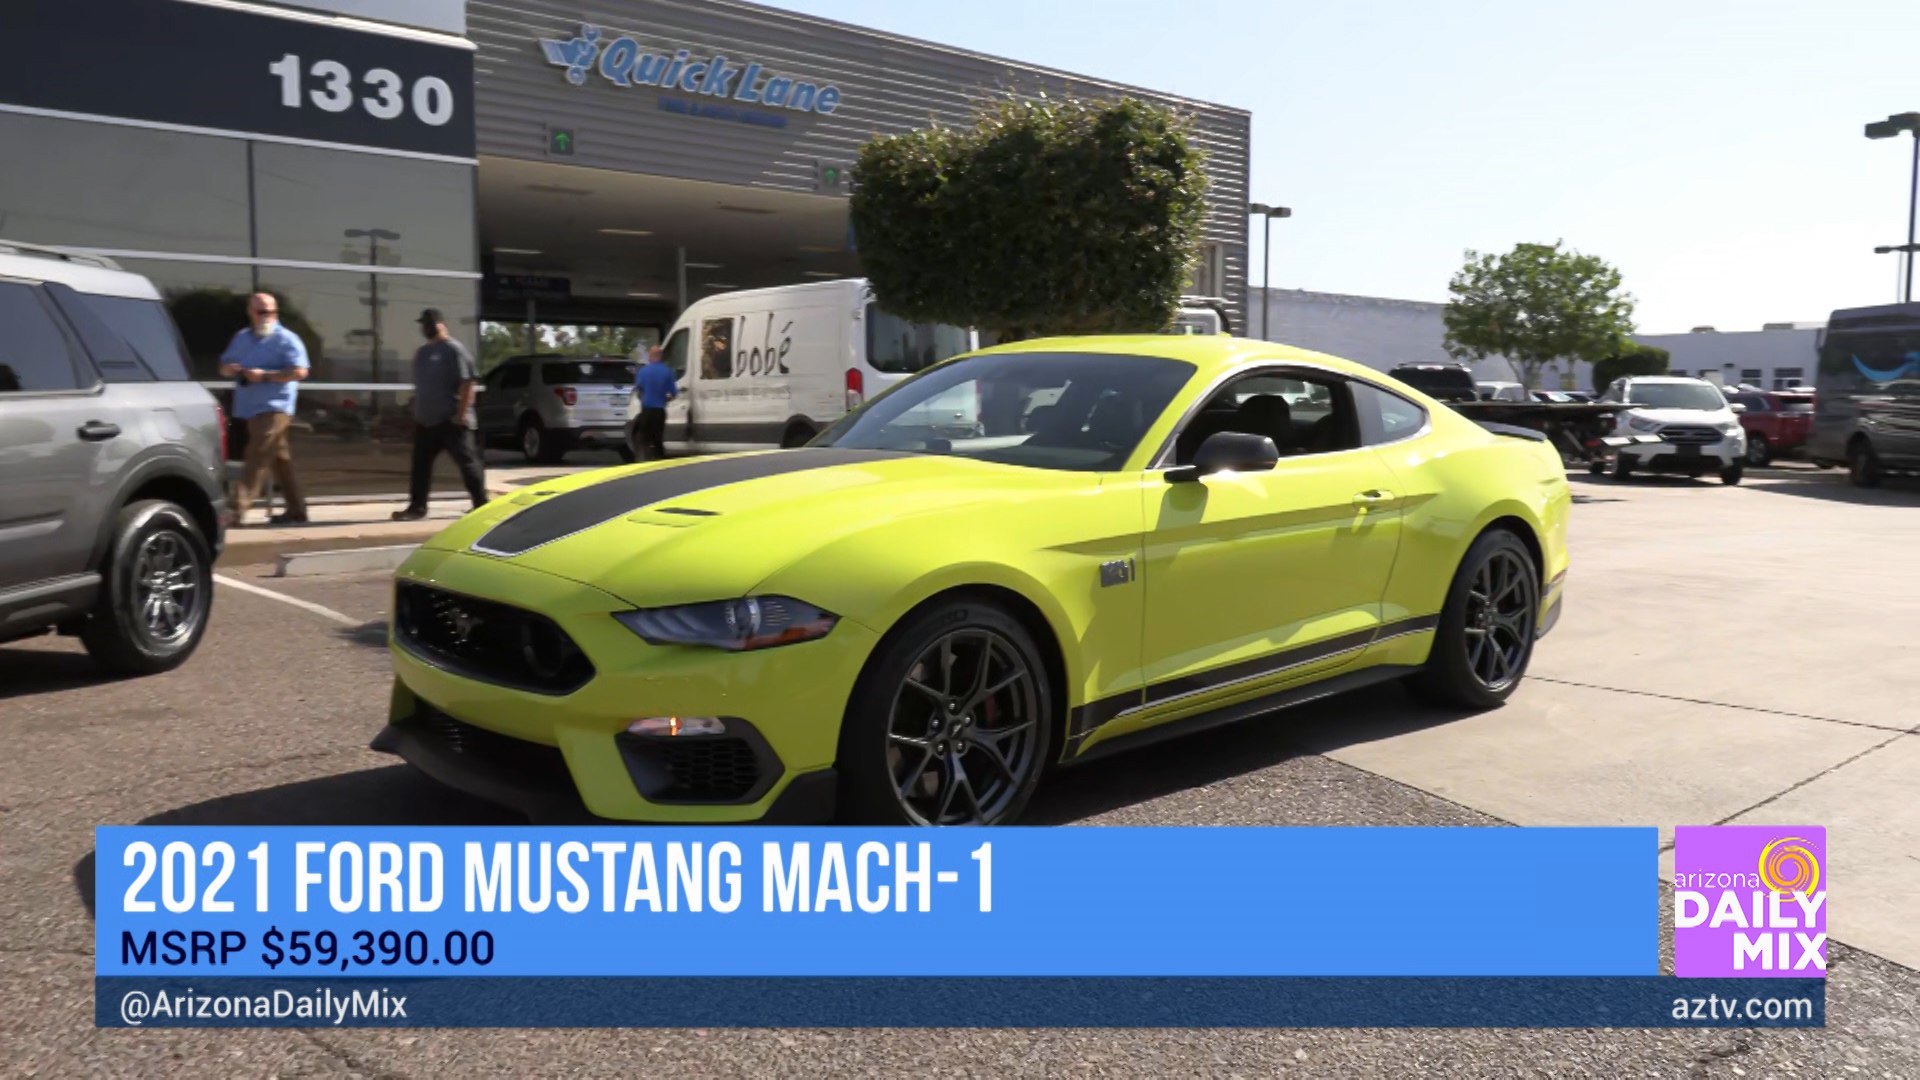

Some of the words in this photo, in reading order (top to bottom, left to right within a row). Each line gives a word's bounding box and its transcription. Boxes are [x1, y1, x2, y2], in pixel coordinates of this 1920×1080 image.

[270, 54, 455, 126] 1330
[599, 37, 738, 98] Quick
[735, 62, 841, 114] Lane
